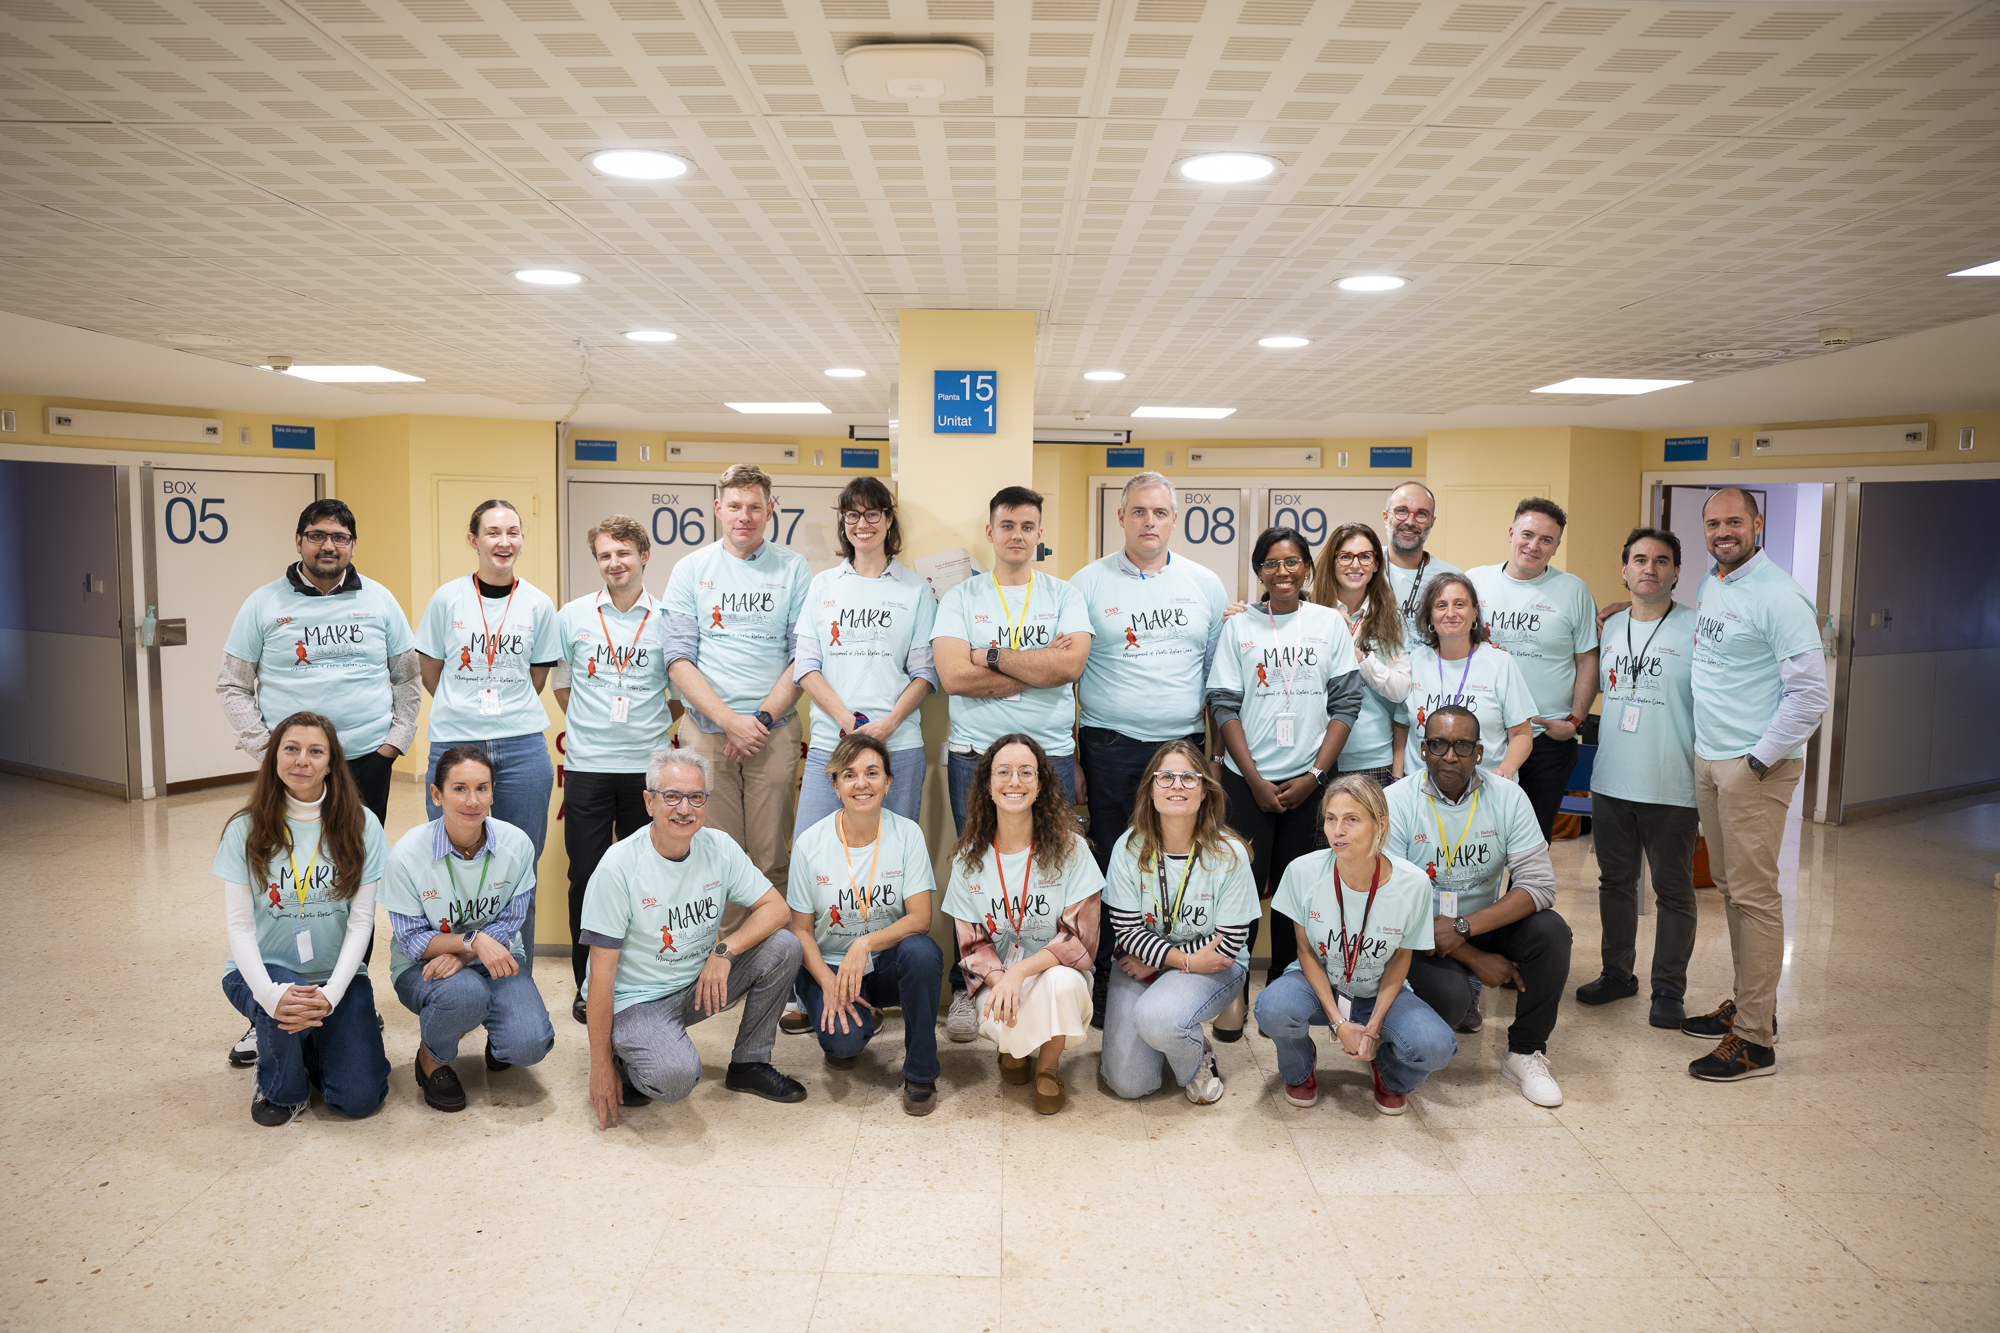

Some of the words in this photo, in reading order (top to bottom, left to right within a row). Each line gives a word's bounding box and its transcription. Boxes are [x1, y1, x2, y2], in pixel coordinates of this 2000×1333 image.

[937, 393, 960, 401] Planta
[960, 374, 994, 401] 15
[938, 415, 972, 427] Unitat
[983, 404, 993, 427] 1
[163, 481, 197, 494] BOX
[1185, 493, 1211, 504] BOX
[652, 494, 680, 505] BOX
[1274, 494, 1302, 505] BOX
[165, 496, 229, 544] 05
[652, 506, 706, 546] 06
[1184, 506, 1235, 545] 08
[722, 592, 774, 612] MARB
[840, 608, 892, 628] MARB
[1131, 608, 1188, 632] MARB
[1491, 610, 1541, 632] MARB
[1698, 614, 1724, 642] MARB
[304, 624, 364, 646] MARB
[471, 632, 523, 655] MARB
[998, 625, 1049, 647] MARB
[597, 644, 649, 668] MARB
[1264, 646, 1318, 668] MARB
[1615, 655, 1663, 677] MARB
[1426, 693, 1477, 713] MARB
[1436, 843, 1491, 868] MARB
[449, 895, 501, 923] MARB
[839, 884, 897, 911] MARB
[991, 894, 1050, 920] MARB
[669, 896, 719, 931] MARB
[1310, 910, 1321, 918] svs
[1327, 929, 1388, 959] MARB
